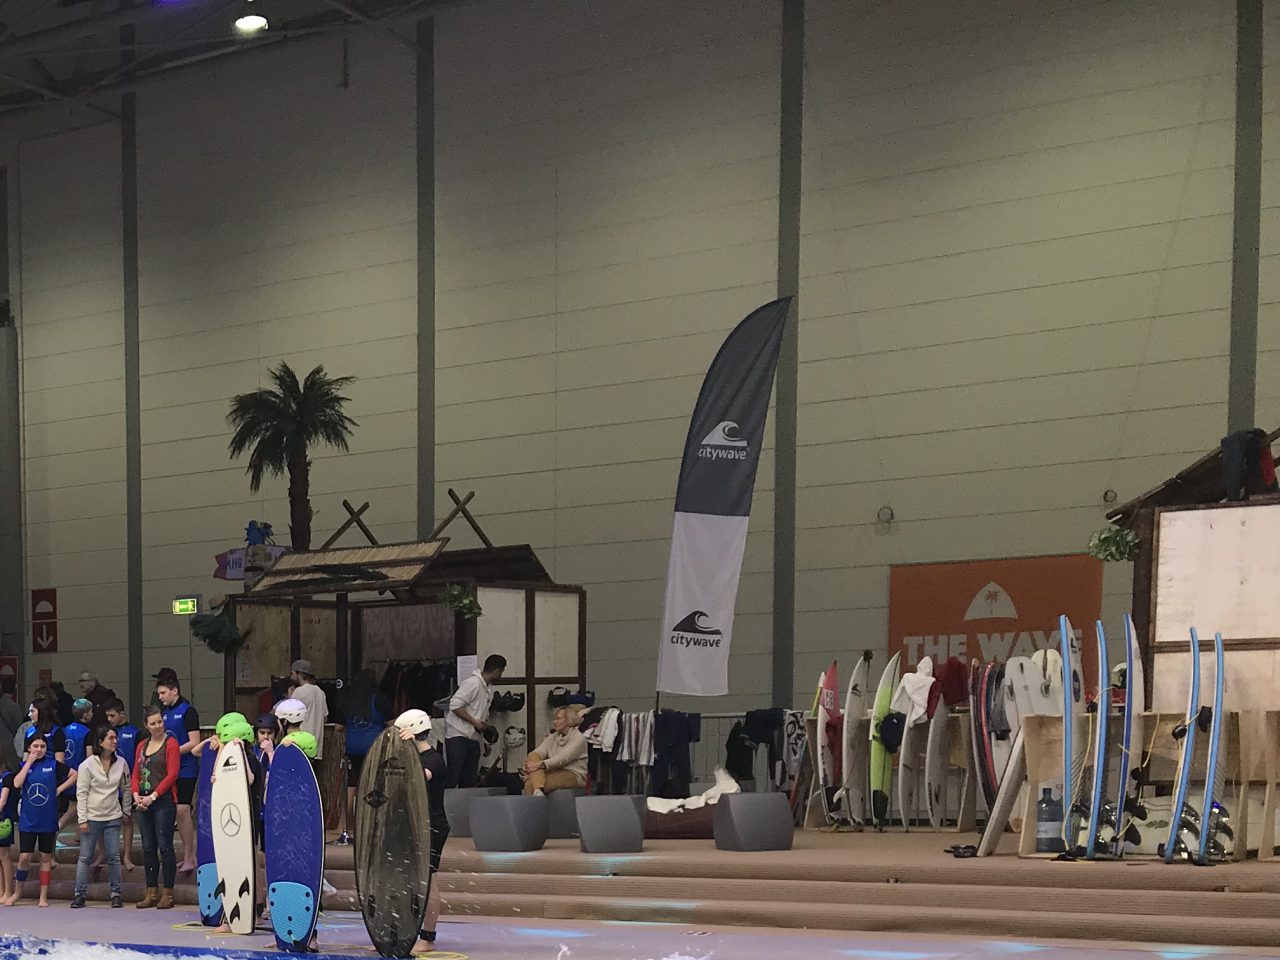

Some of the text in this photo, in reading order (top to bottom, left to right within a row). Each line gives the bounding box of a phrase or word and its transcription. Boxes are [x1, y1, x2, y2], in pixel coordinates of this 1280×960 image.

[698, 446, 747, 460] citywave
[670, 633, 721, 648] citywave
[903, 633, 967, 666] THE
